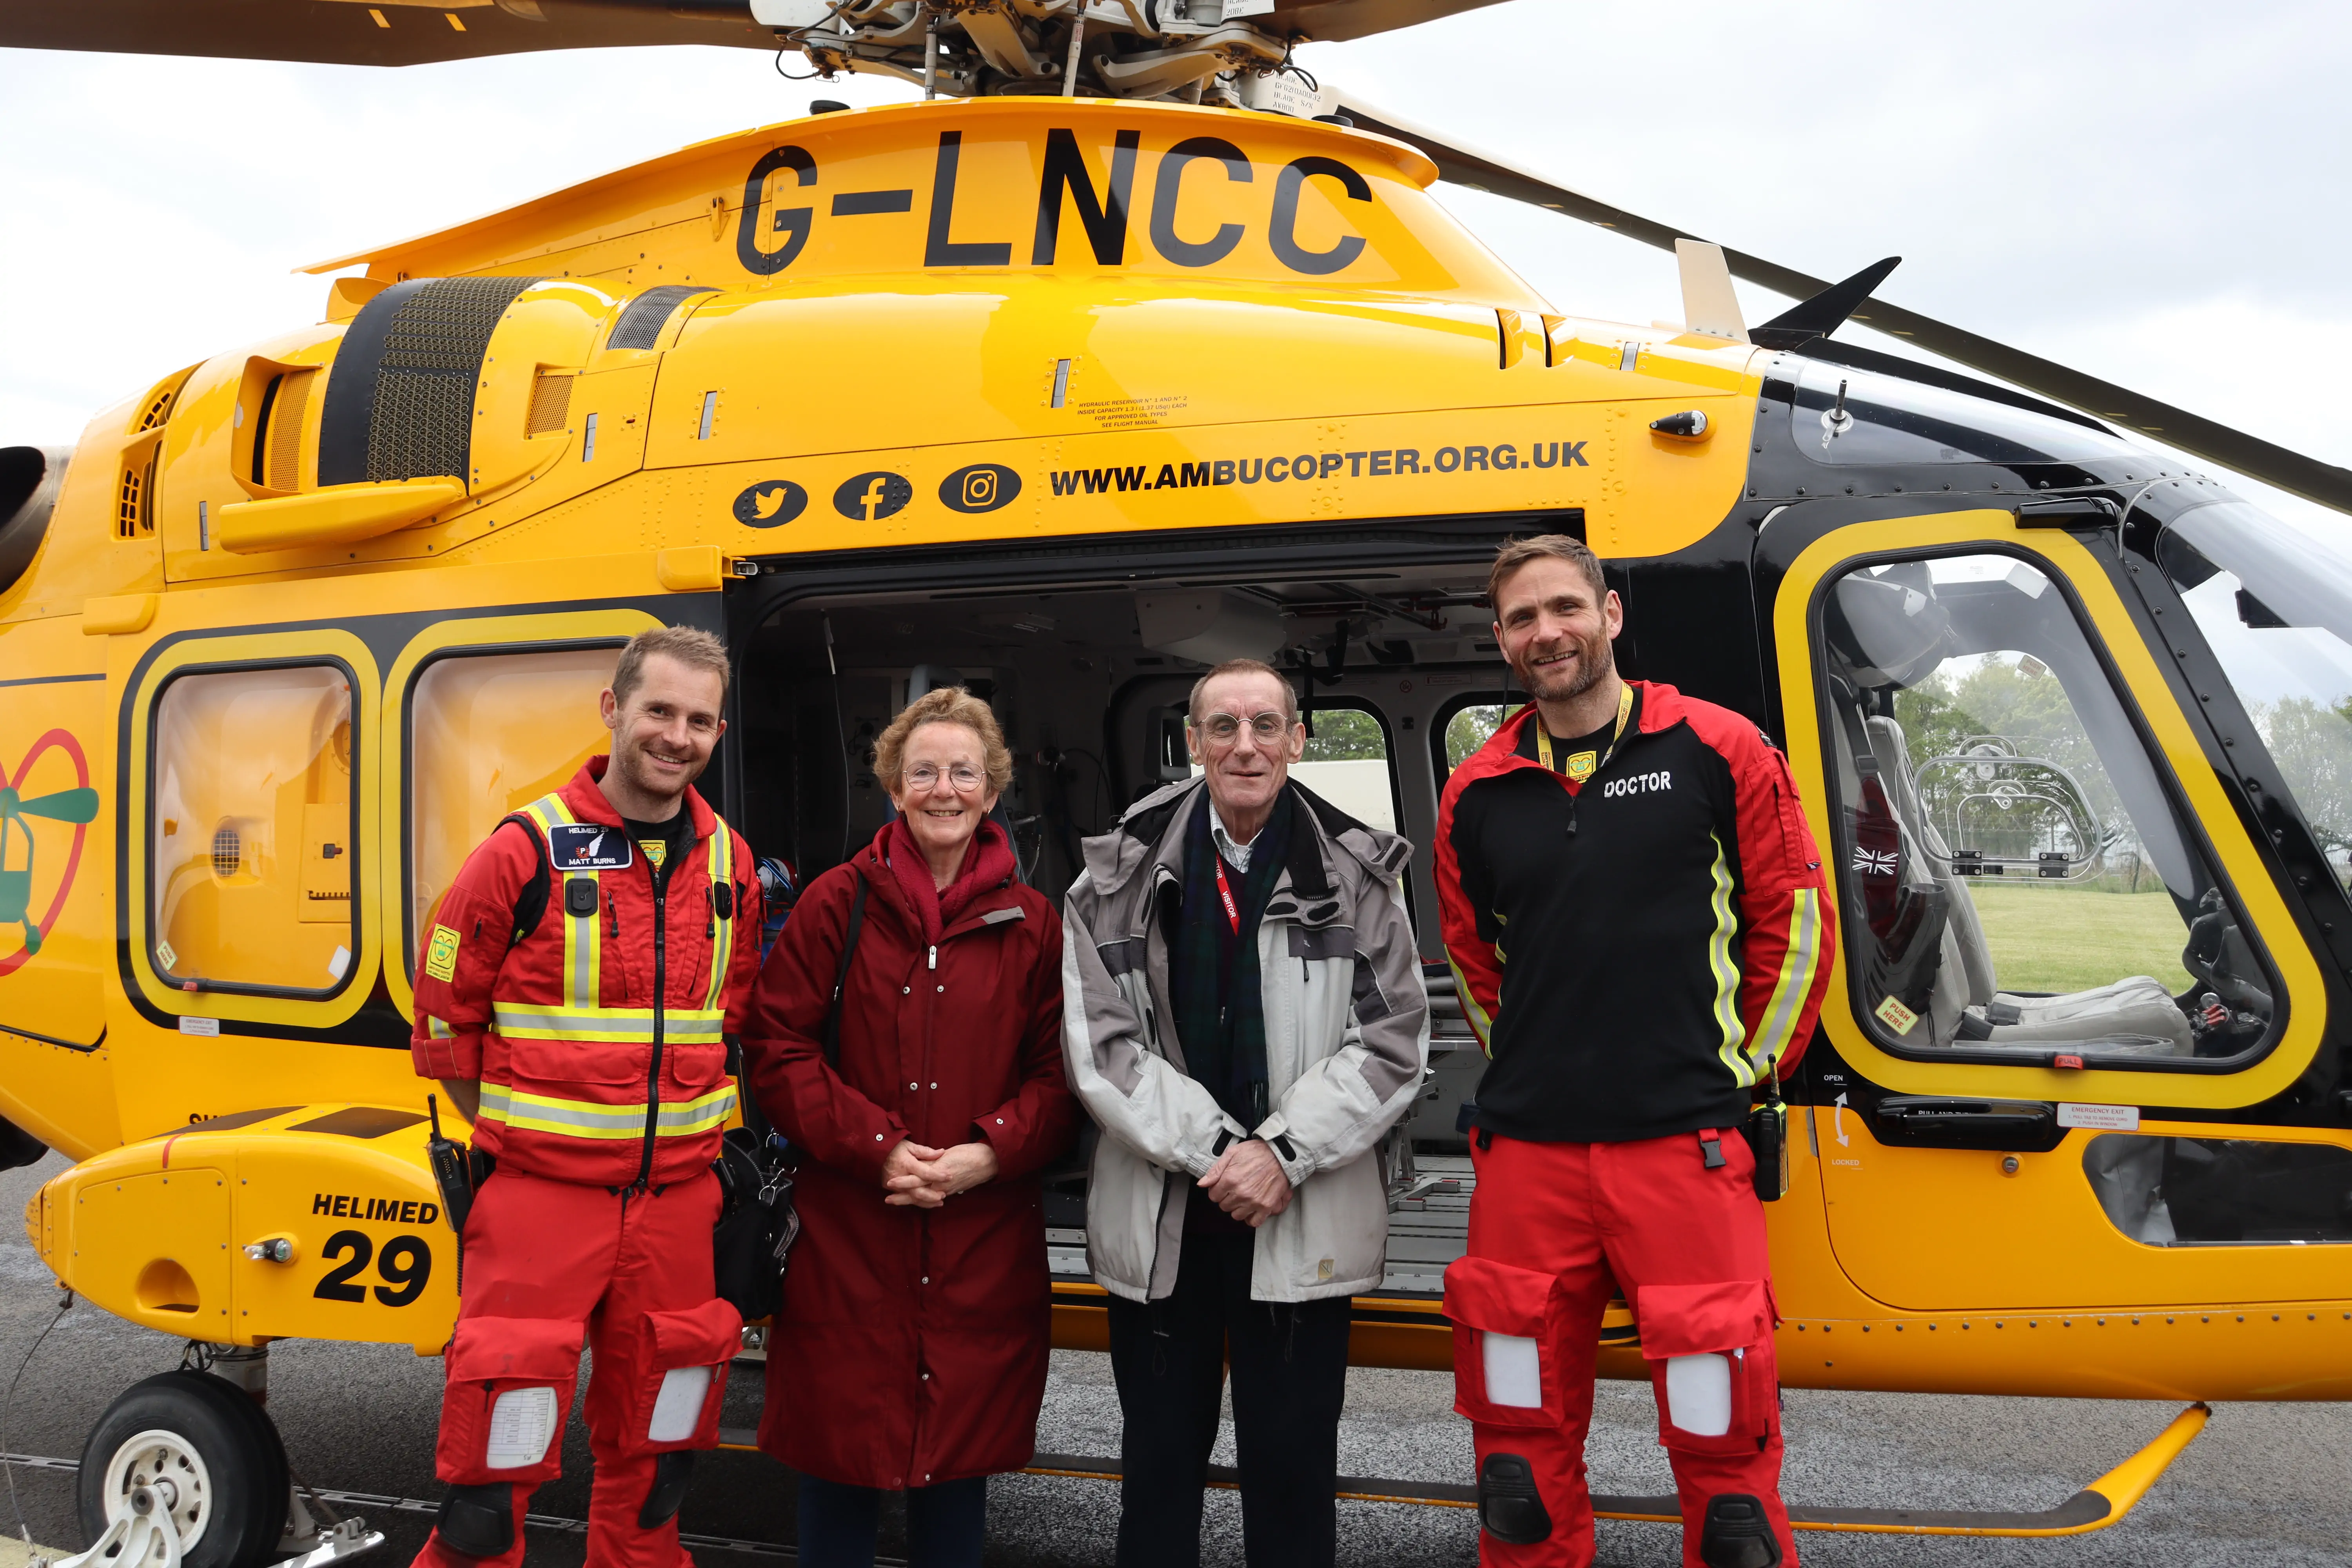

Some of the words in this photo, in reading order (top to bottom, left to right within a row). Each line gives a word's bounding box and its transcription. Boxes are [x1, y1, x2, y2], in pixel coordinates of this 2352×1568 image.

[1274, 91, 1295, 103] BLADE
[1301, 99, 1313, 109] S/N
[736, 127, 1373, 276] G-LNCC
[1050, 441, 1590, 495] WWW.AMBUCOPTER.ORG.UK
[2023, 664, 2038, 676] HERE
[2026, 659, 2041, 671] PUSH
[1604, 771, 1671, 798] DOCTOR
[1222, 890, 1236, 918] VISITOR
[160, 950, 169, 965] HERE
[163, 945, 173, 960] PUSH
[1883, 1010, 1904, 1029] HERE
[1889, 1002, 1911, 1022] PUSH
[312, 1193, 439, 1224] HELIMED
[312, 1230, 432, 1307] 29
